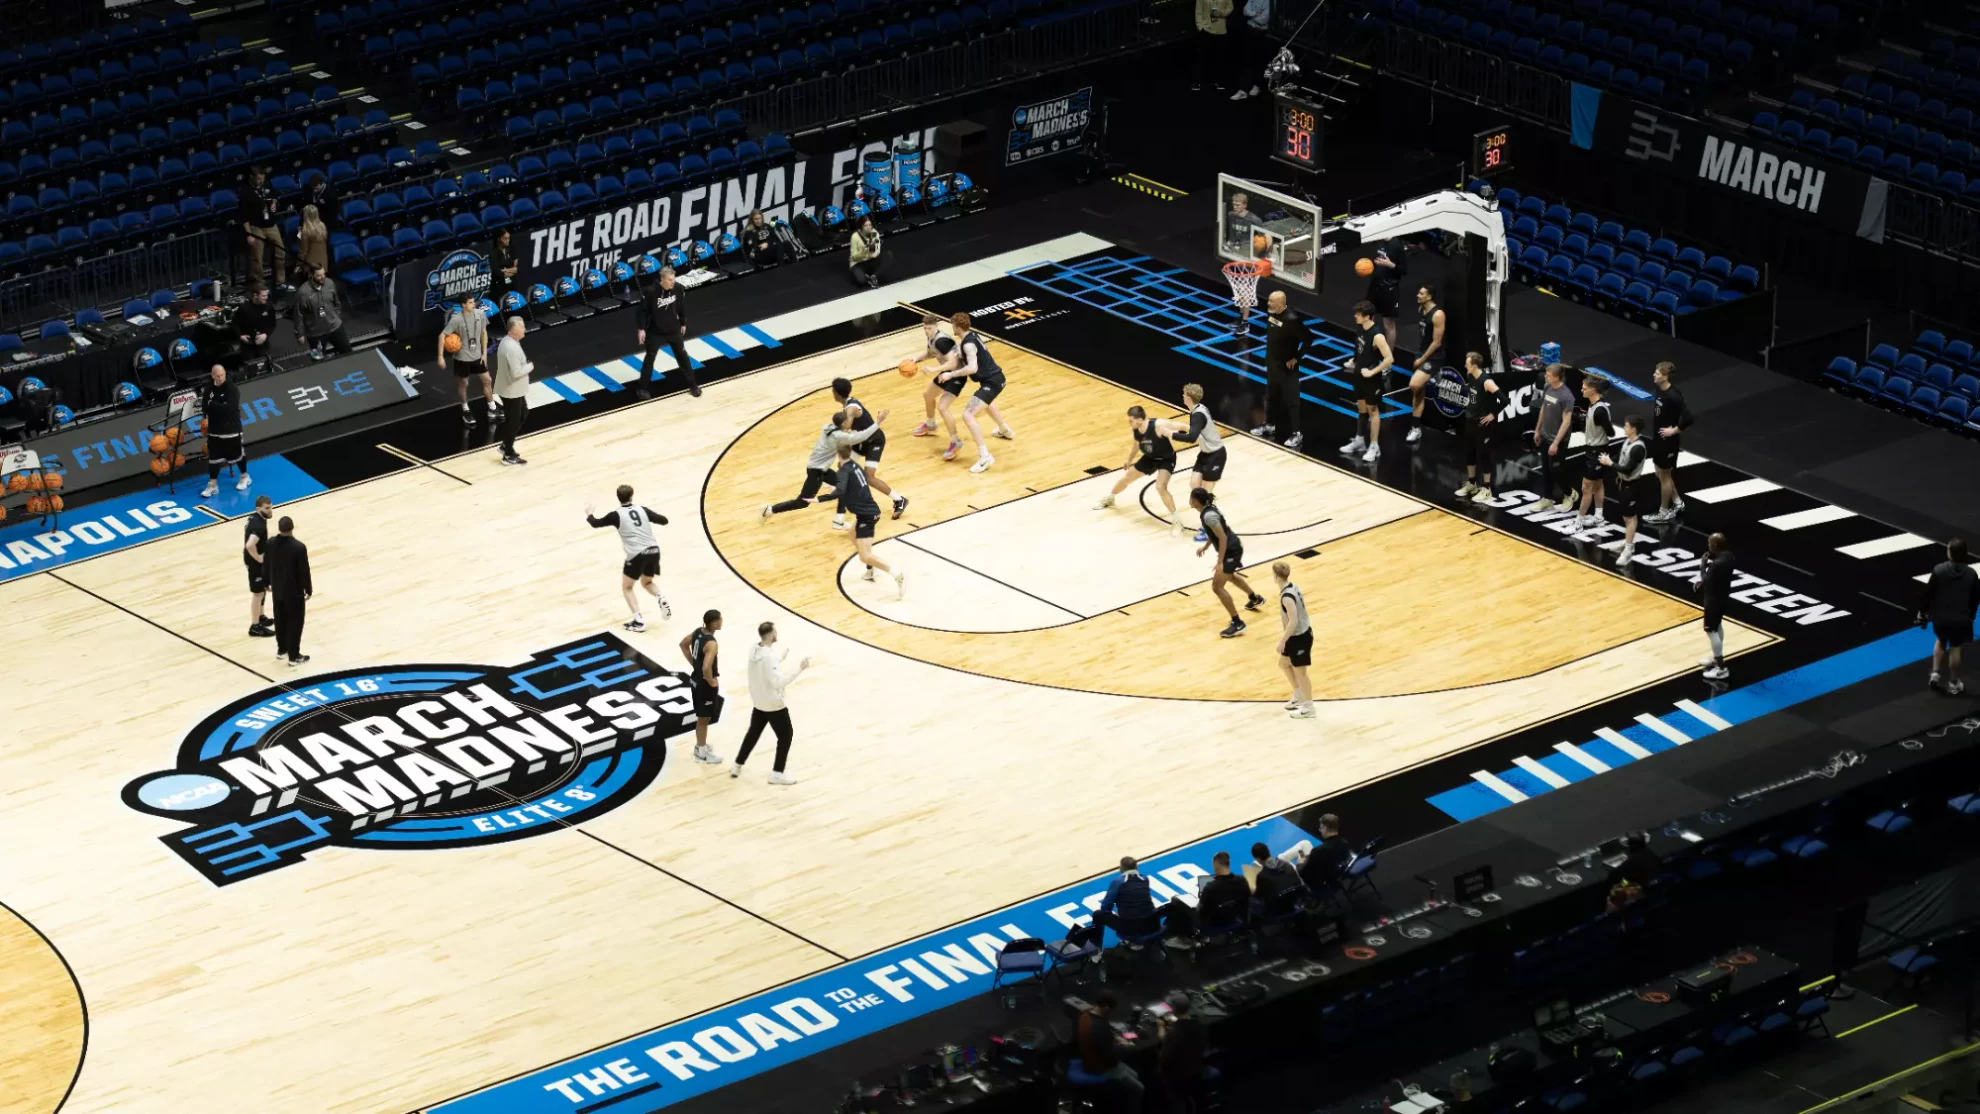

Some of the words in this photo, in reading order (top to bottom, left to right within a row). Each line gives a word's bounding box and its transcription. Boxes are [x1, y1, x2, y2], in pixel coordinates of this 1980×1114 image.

[1027, 99, 1069, 125] MARCH
[1032, 109, 1088, 139] MADNESS
[1291, 109, 1314, 131] 3:00
[1287, 126, 1311, 160] 30
[1486, 133, 1506, 150] 3:00
[1485, 149, 1500, 167] 30
[1699, 135, 1826, 214] MARCH
[677, 161, 815, 252] FINAL
[530, 219, 585, 268] THE
[592, 197, 671, 252] ROAD
[440, 263, 478, 285] MARCH
[571, 258, 590, 280] TO
[594, 249, 622, 272] THE
[969, 301, 1016, 318] HOSTED
[72, 424, 165, 470] FINA
[629, 509, 642, 527] 9
[235, 687, 329, 730] SWEET
[218, 683, 523, 796] MARCH
[314, 676, 695, 816] MADNESS
[158, 781, 230, 809] NCAA
[472, 799, 573, 833] ELITE
[824, 987, 857, 1003] TO
[838, 992, 884, 1014] THE
[543, 1057, 651, 1104] THE
[645, 996, 840, 1082] ROAD
